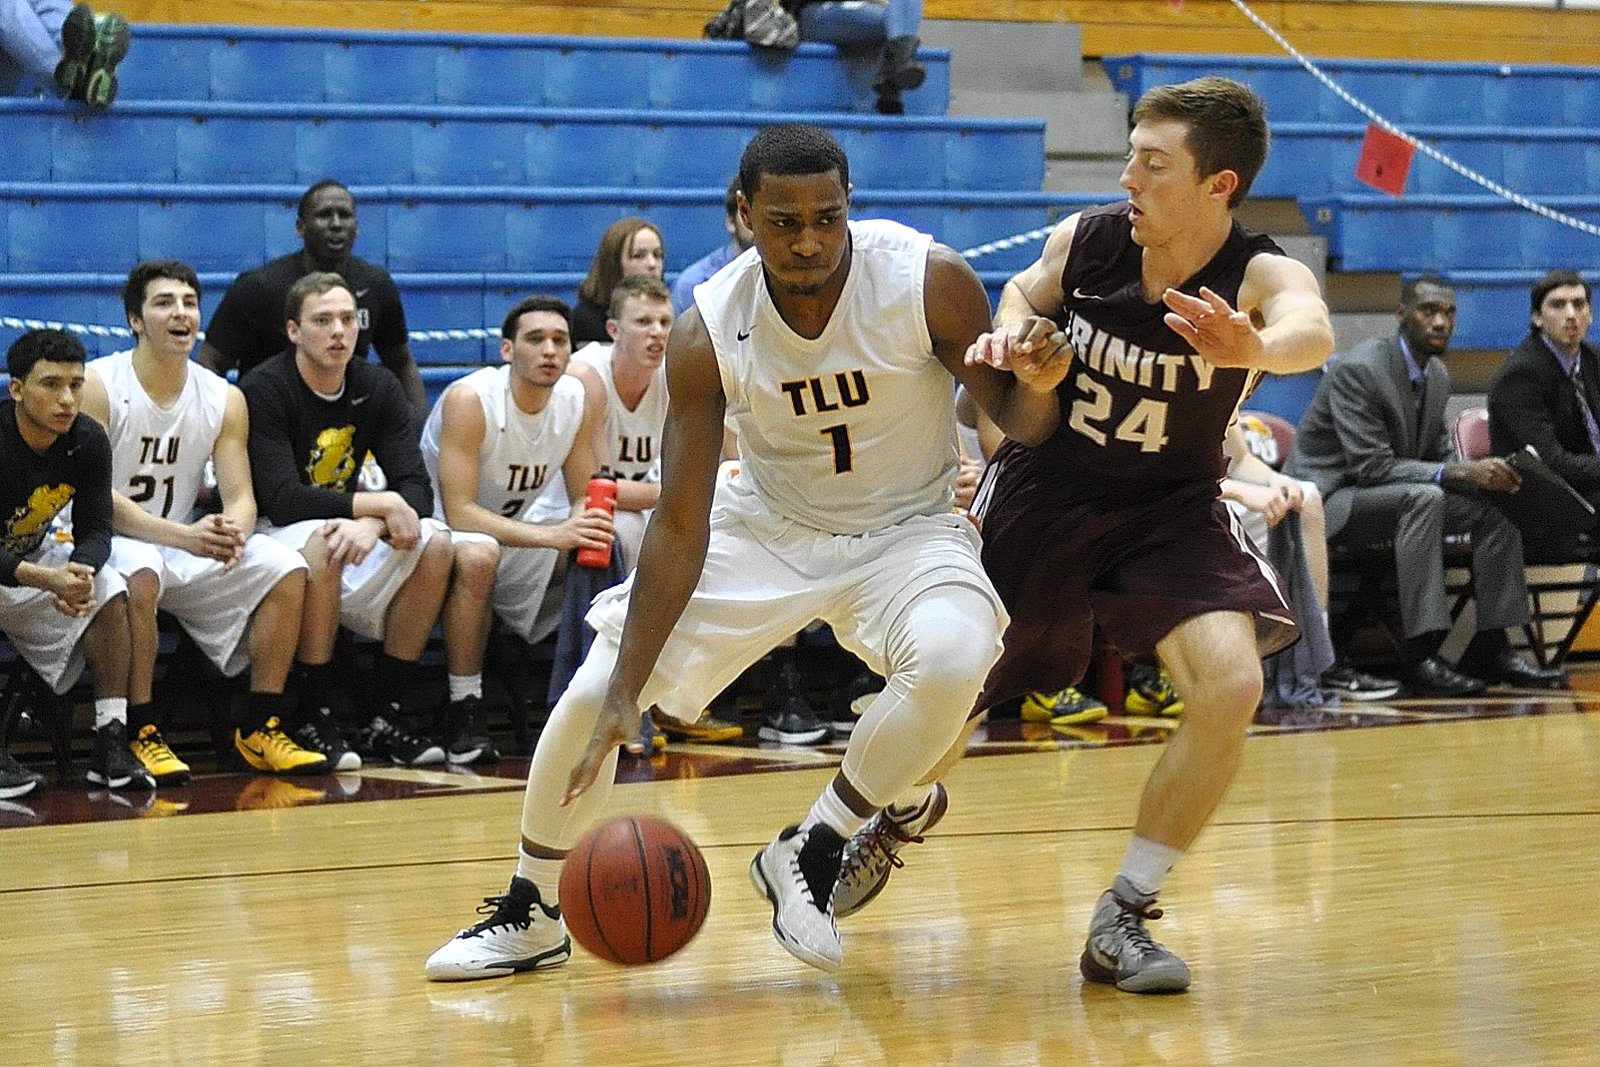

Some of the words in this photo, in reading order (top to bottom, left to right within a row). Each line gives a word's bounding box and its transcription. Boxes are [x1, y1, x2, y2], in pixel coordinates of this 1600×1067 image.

[1064, 309, 1216, 392] RINITY
[780, 368, 872, 417] TLU
[1069, 372, 1169, 453] 24
[140, 435, 180, 465] TLU
[618, 435, 652, 462] LU
[818, 423, 854, 475] 1
[128, 474, 175, 519] 21
[507, 464, 548, 492] TLU
